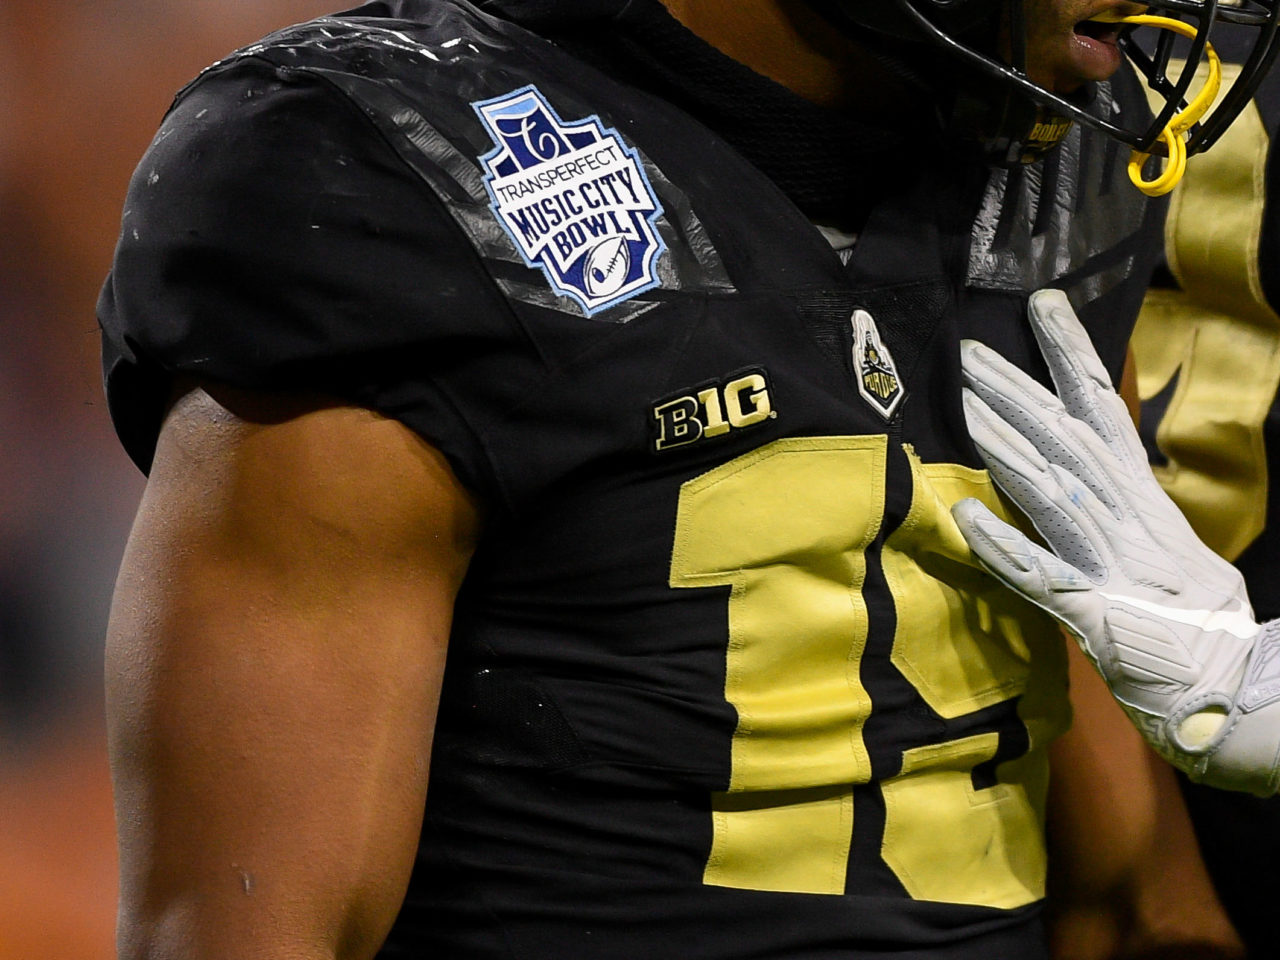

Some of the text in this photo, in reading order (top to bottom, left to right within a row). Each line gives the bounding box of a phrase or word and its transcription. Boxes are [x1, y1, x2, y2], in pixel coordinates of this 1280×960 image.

[496, 145, 620, 203] TRANSPERFECT
[507, 167, 641, 249] MUSIC CITY
[552, 210, 632, 262] BOWL
